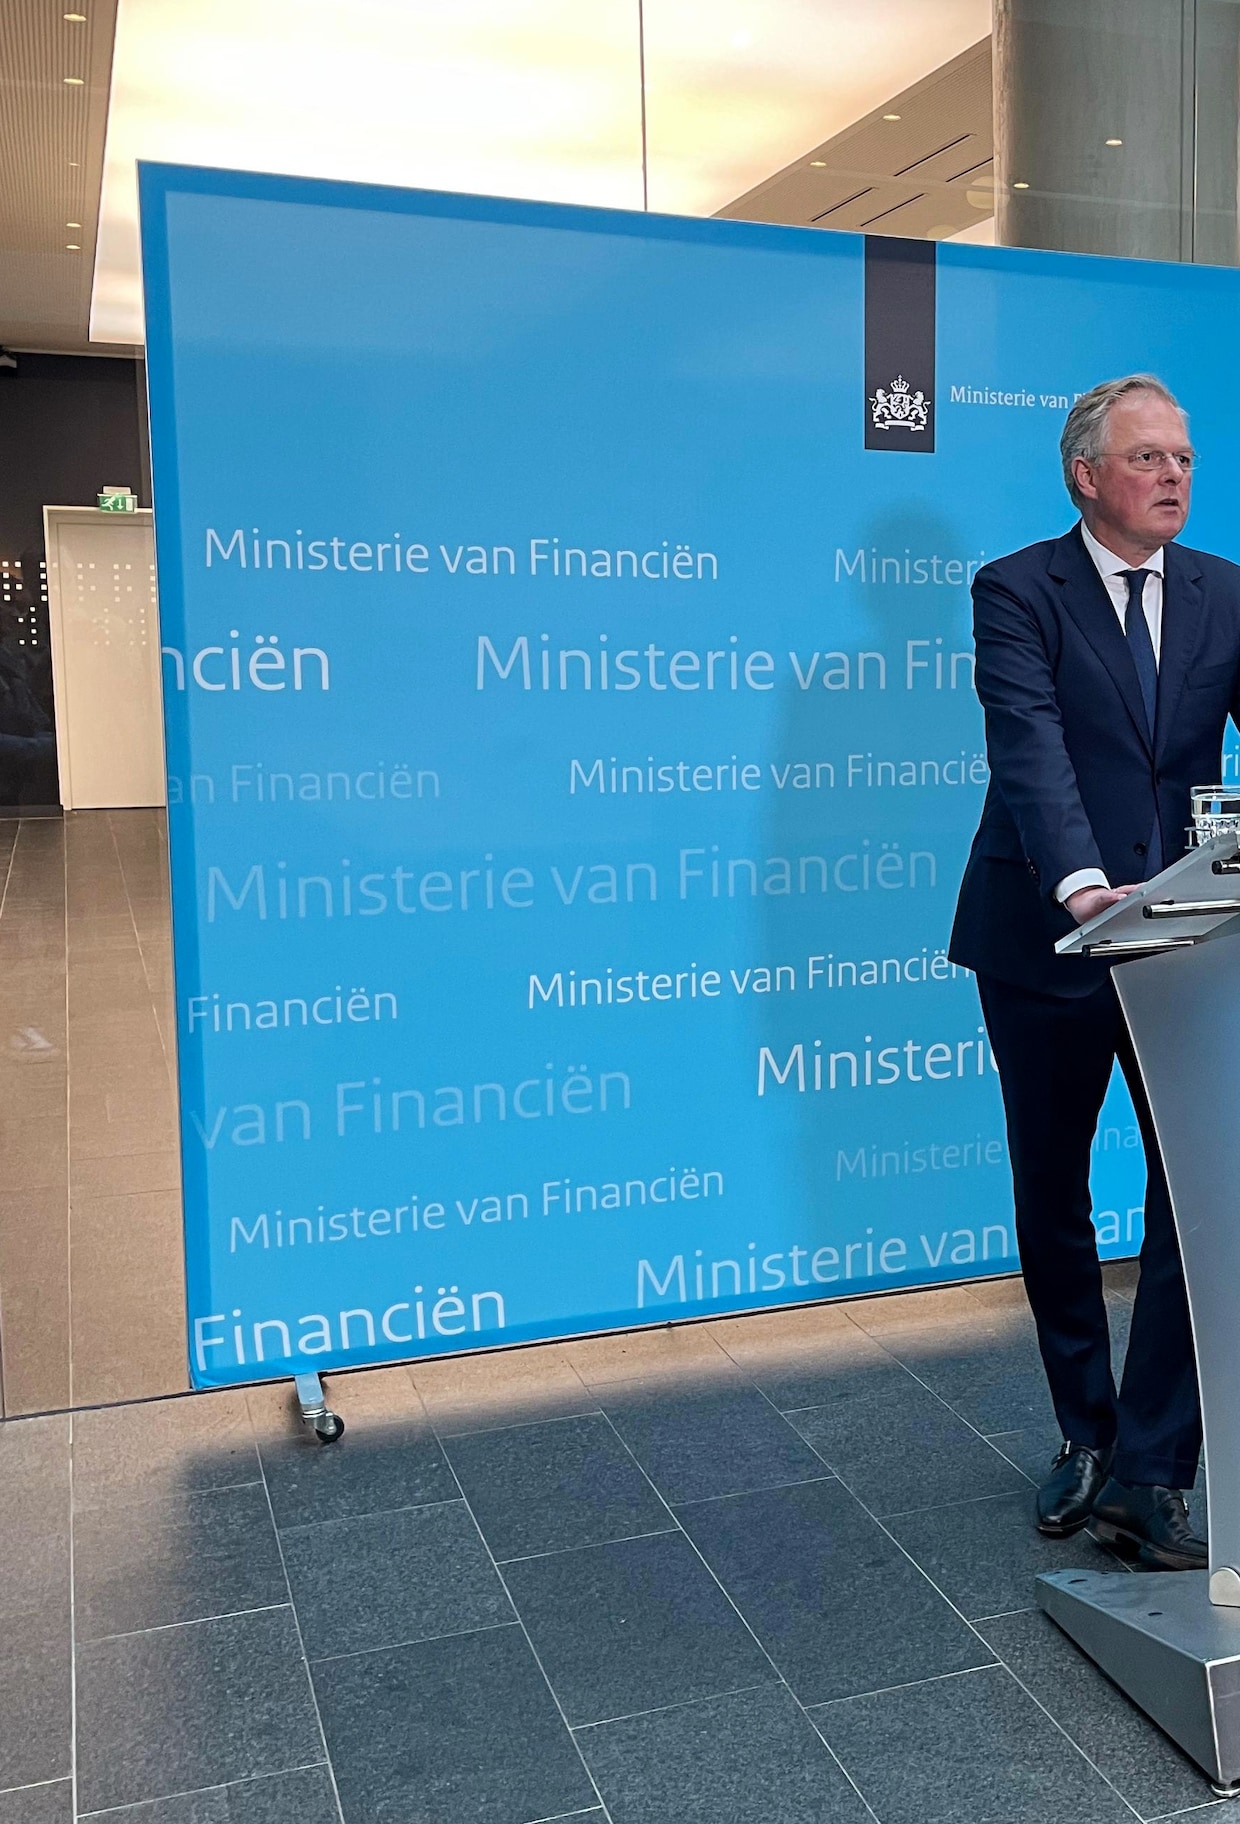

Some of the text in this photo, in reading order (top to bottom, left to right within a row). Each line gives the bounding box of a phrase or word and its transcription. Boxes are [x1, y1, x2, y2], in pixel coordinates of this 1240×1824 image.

[949, 385, 1036, 407] Ministerie
[1039, 394, 1069, 409] van
[205, 528, 718, 580] Ministerie van Financiën
[475, 633, 775, 691] Ministerie
[788, 651, 887, 691] van
[232, 761, 440, 803] Financiën
[569, 751, 988, 795] Ministerie van Financië
[207, 839, 937, 923] Ministerie van Financiën
[187, 985, 398, 1034] Financiën
[528, 962, 721, 1009] Ministerie
[730, 965, 795, 994] van
[757, 1026, 1000, 1097] Ministeri
[190, 1062, 631, 1149] van Financiën
[836, 1133, 1003, 1182] Ministerie
[230, 1167, 724, 1253] Ministerie van Financiën
[637, 1223, 1009, 1309] Ministerie van
[194, 1285, 506, 1372] Financiën
